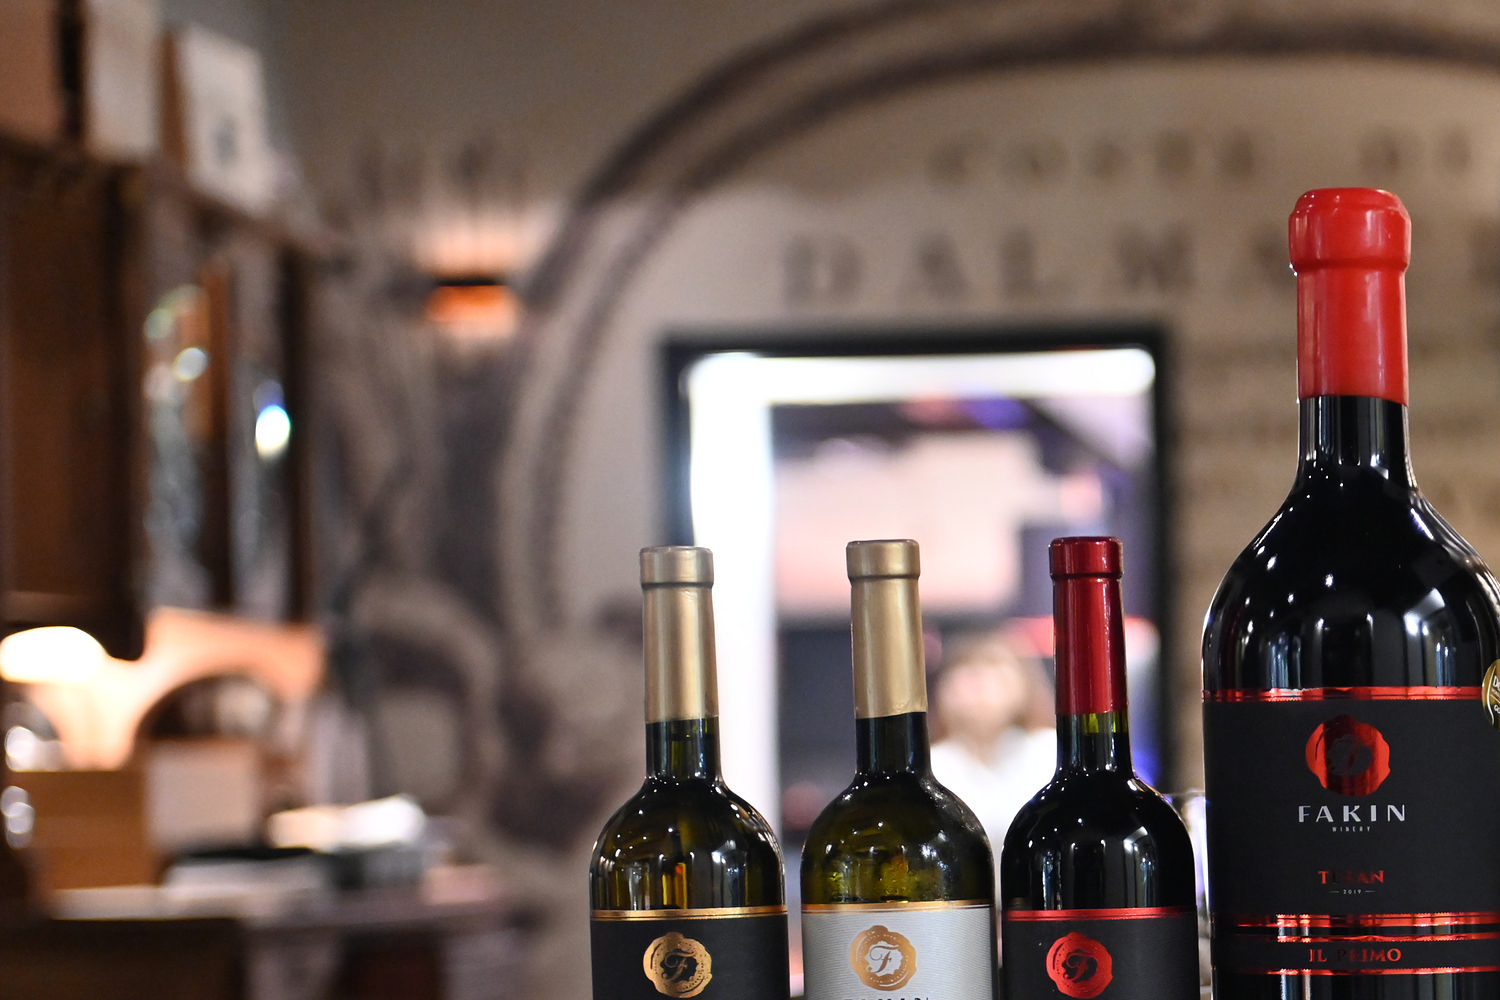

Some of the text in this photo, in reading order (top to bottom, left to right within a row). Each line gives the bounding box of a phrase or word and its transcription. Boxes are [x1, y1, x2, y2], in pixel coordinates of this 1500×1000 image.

[1298, 804, 1405, 823] FAKIN
[1309, 948, 1402, 962] IL PRIMO
